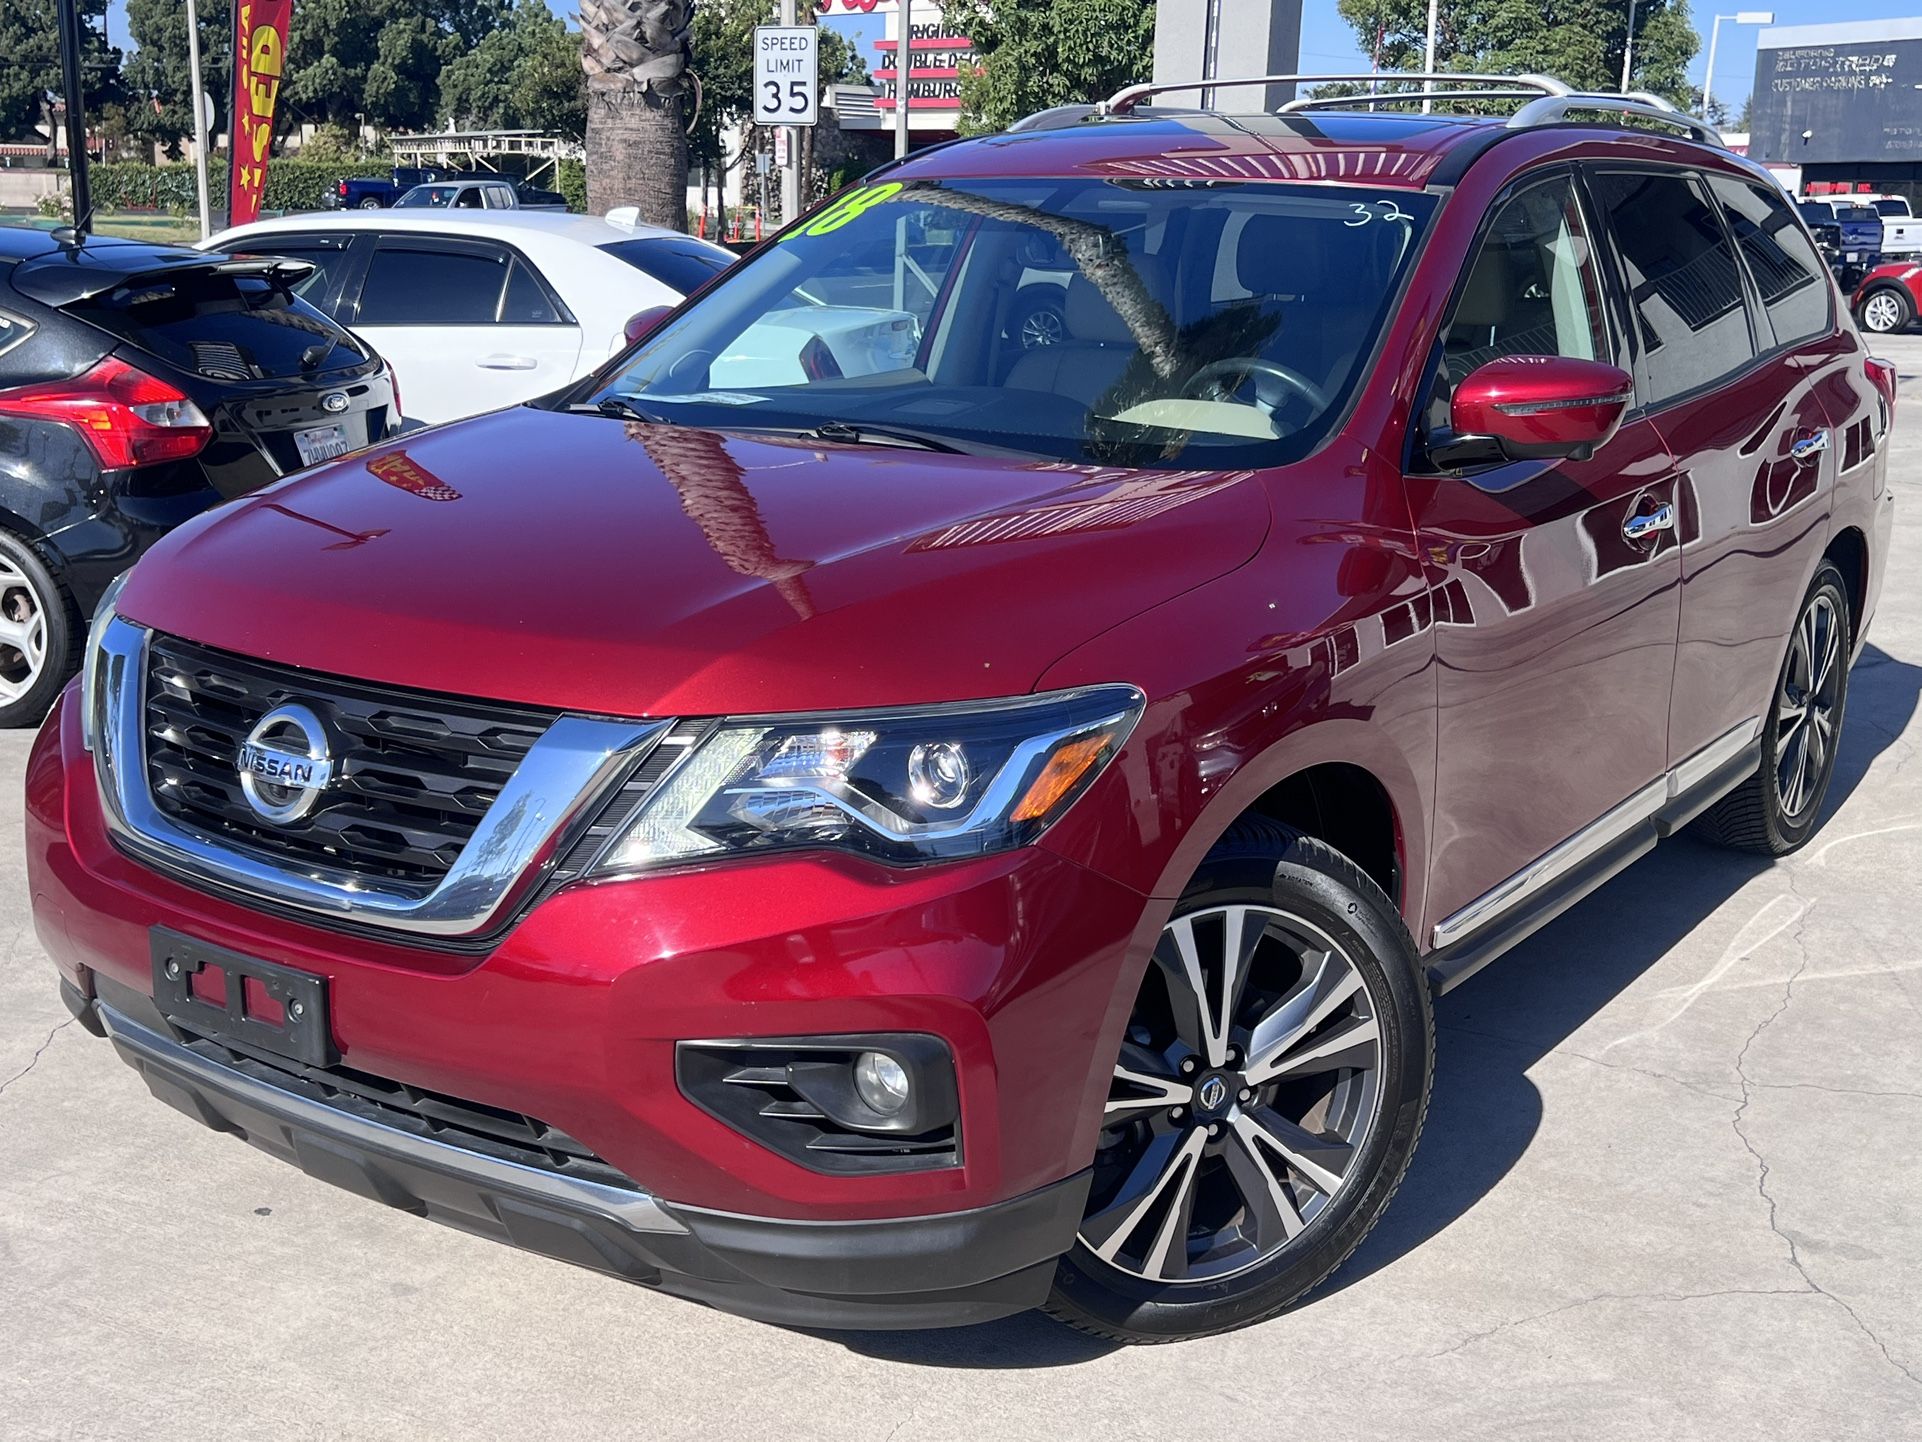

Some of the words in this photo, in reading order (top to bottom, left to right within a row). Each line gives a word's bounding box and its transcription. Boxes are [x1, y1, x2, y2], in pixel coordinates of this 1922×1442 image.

[762, 37, 808, 51] SPEED
[766, 59, 803, 73] LIMIT
[882, 53, 946, 70] DOBLE
[762, 80, 809, 114] 35
[886, 82, 961, 99] HMBURG
[777, 183, 903, 242] 18
[1343, 200, 1415, 227] 32
[241, 749, 313, 783] NISSAN
